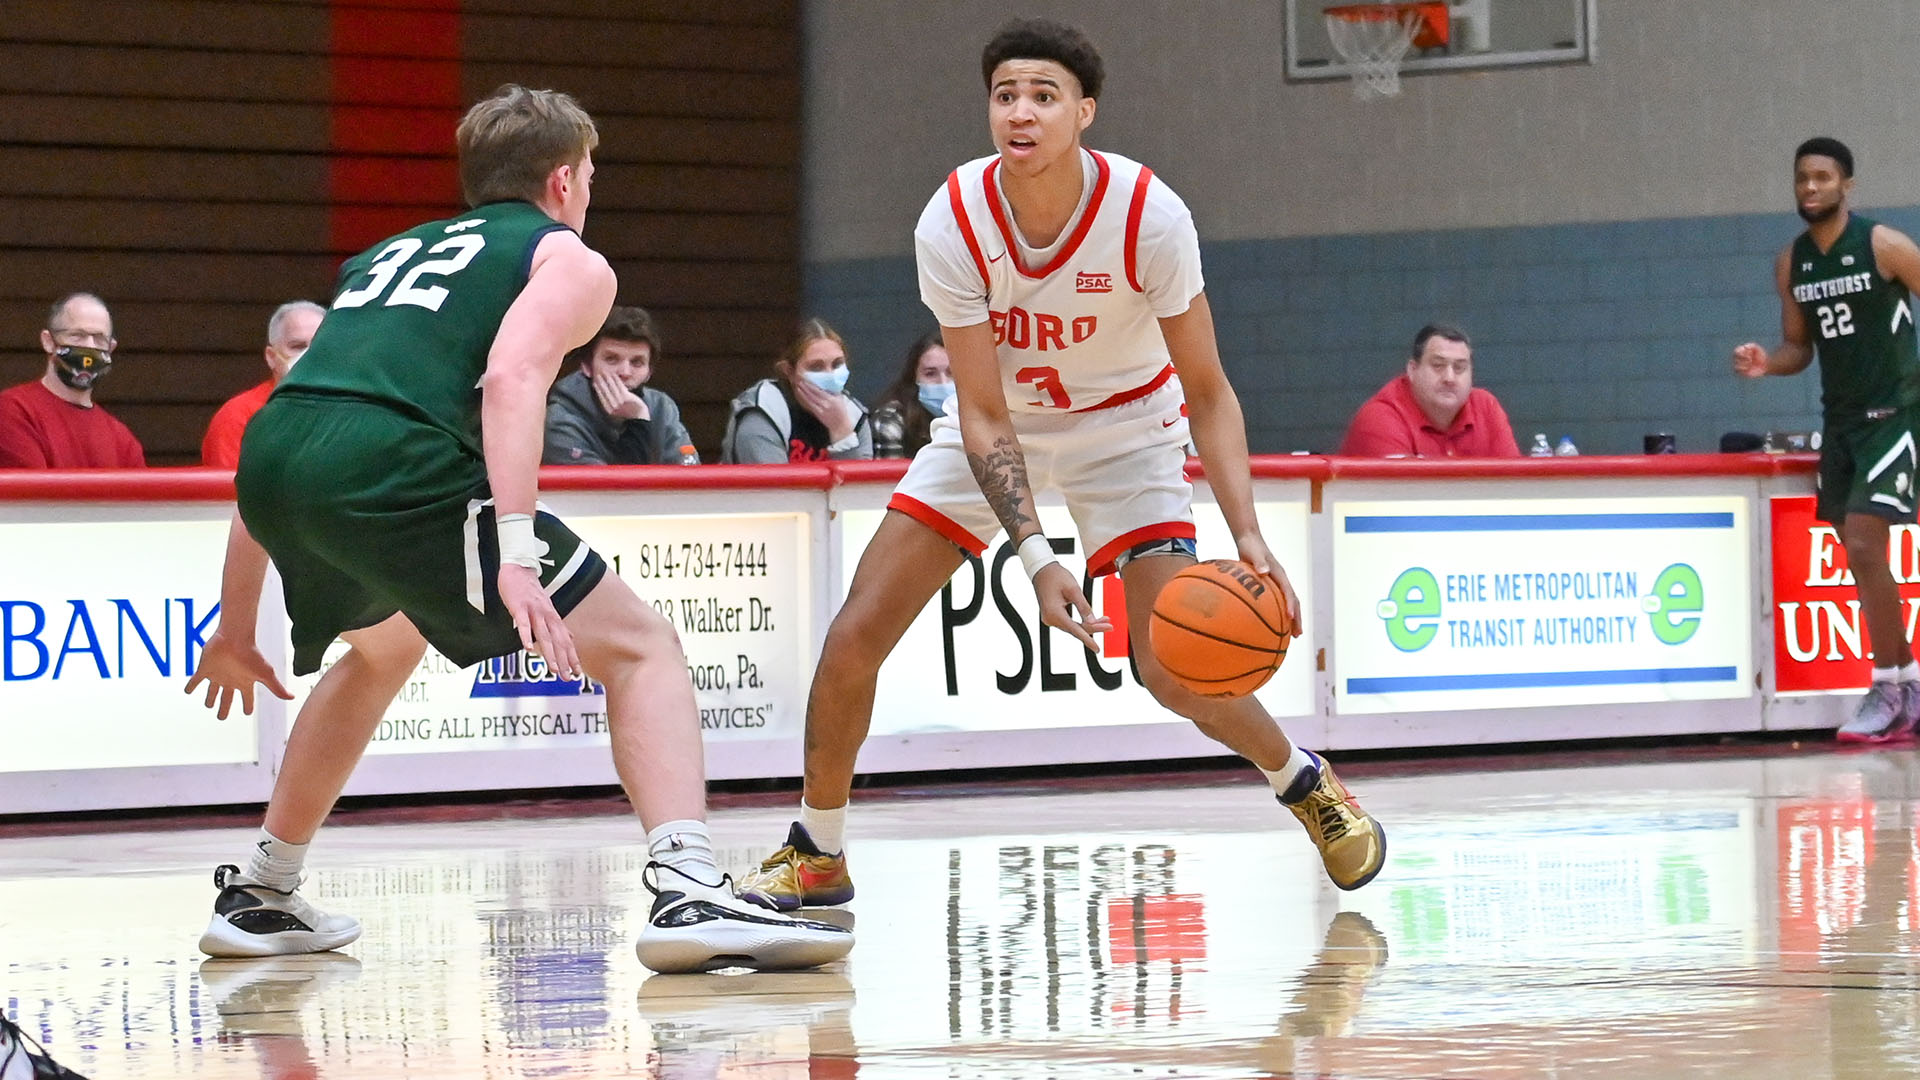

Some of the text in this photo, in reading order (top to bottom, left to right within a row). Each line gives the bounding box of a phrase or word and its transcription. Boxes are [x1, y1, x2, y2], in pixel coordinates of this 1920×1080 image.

[333, 233, 486, 312] 32
[1076, 278, 1113, 289] PSAC
[1817, 302, 1855, 339] 22
[1016, 366, 1072, 409] 3
[640, 542, 768, 579] 814-734-7444
[1446, 571, 1638, 603] ERIE METROPOLITAN
[681, 597, 743, 634] Walker
[749, 597, 775, 632] Dr.
[941, 537, 1146, 697] PSEC
[1447, 616, 1638, 648] TRANSIT AUTHORITY
[0, 597, 222, 681] BANK
[737, 654, 764, 689] Pa.
[373, 718, 431, 742] DING
[439, 717, 475, 739] ALL
[481, 713, 577, 739] PHYSICAL
[701, 703, 773, 730] RVICES"
